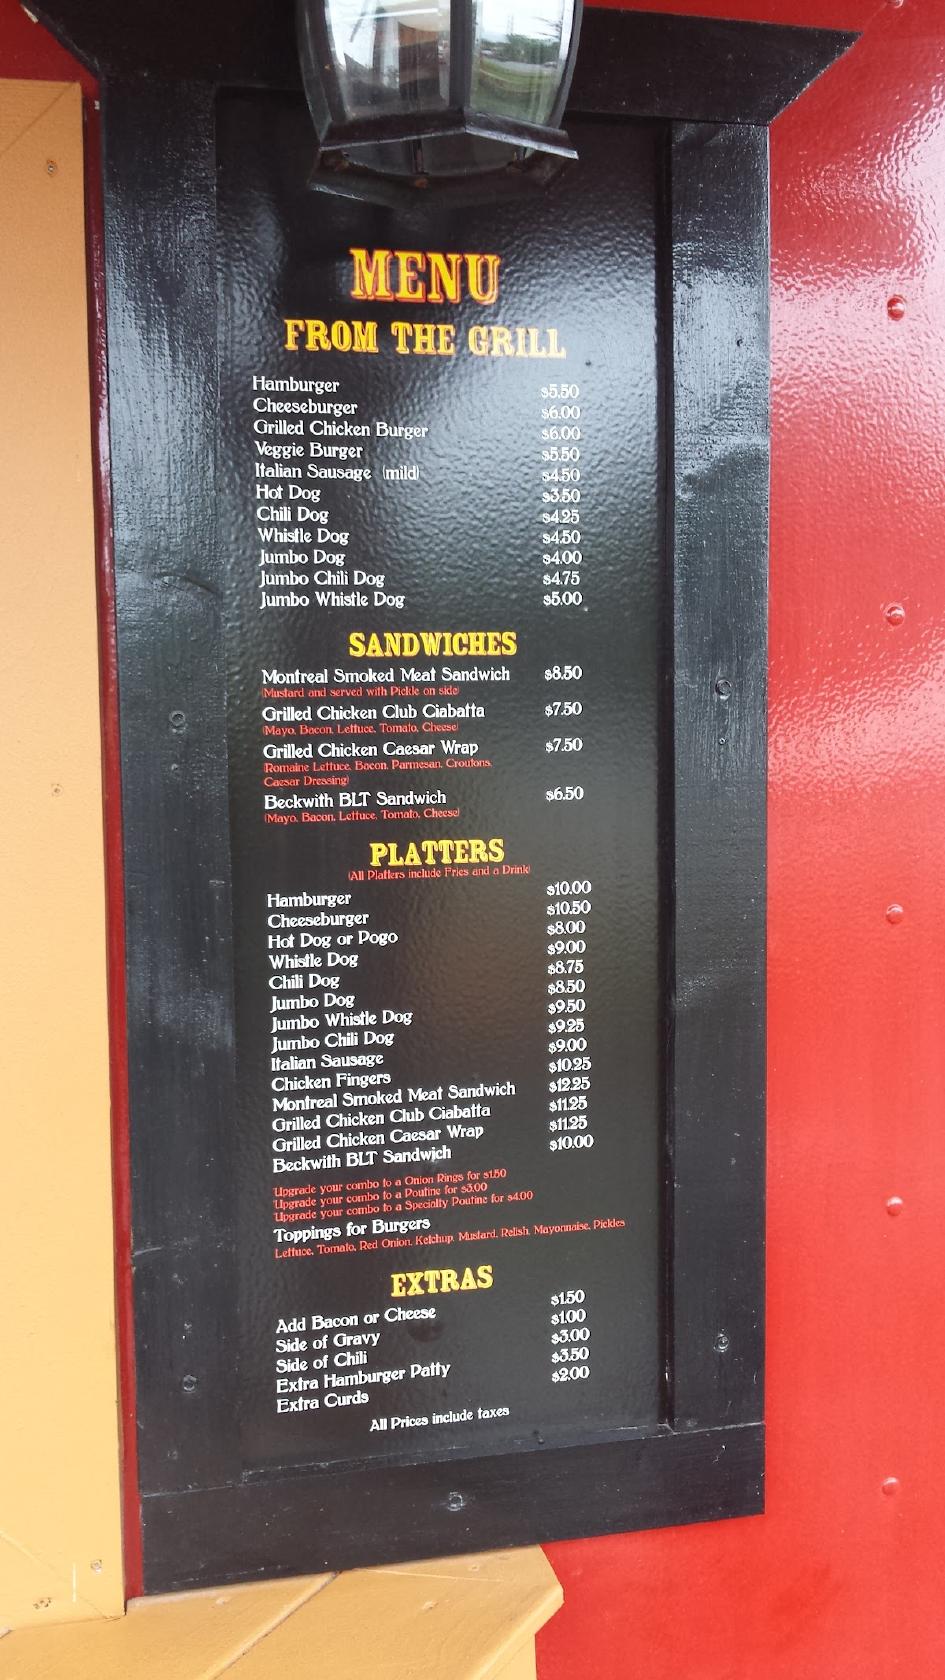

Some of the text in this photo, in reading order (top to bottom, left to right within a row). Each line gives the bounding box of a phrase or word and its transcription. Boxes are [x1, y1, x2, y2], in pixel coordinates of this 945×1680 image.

[350, 248, 500, 304] MENU
[285, 320, 566, 357] FROM THE GRILL
[253, 376, 339, 394] Hamburger
[541, 384, 579, 399] $5.50
[253, 398, 358, 417] Cheeseburger
[542, 405, 580, 420] $6.00
[254, 420, 429, 441] Grilled Chicken Burger
[542, 426, 580, 440] $6.00
[254, 441, 363, 460] Veggie Burger
[542, 446, 580, 462] $5.50
[255, 462, 420, 482] Italian Sausage (mild)
[541, 467, 580, 483] $4.50
[256, 484, 320, 502] Hot Dog
[542, 487, 580, 503] $3.50
[257, 506, 329, 524] Chili Dog
[540, 508, 579, 524] $4.25
[258, 528, 349, 546] Whistle Dog
[543, 529, 581, 544] $4.50
[258, 549, 346, 566] Jumbo Dog
[543, 550, 582, 565] $4.00
[259, 570, 385, 588] Jumbo Chili Dog
[543, 571, 580, 585] $4.75
[260, 592, 405, 609] Jumbo Whistle Dog
[543, 591, 582, 606] $5.00
[349, 632, 517, 656] SANDWICHES
[262, 666, 510, 684] Montreal Smoked Meat Sandwich
[545, 666, 582, 680] $8.50
[262, 703, 484, 721] Grilled Chicken Club Ciabatta
[545, 702, 582, 717] $7.50
[263, 740, 478, 758] Grilled Chicken Caesar Wrap
[546, 738, 582, 753] $7.50
[265, 790, 446, 809] Beckwith BLT Sandwich
[546, 786, 584, 802] $6.50
[370, 839, 504, 866] PLATTERS
[368, 870, 405, 880] Platters
[408, 869, 441, 878] include
[445, 868, 469, 877] Fries
[472, 867, 490, 876] and
[493, 868, 499, 876] a
[547, 881, 591, 896] $10.00
[267, 892, 351, 907] Hamburger
[547, 900, 591, 916] $10.50
[268, 912, 369, 928] Cheeseburger
[547, 920, 586, 936] $8.00
[268, 930, 398, 948] Hot Dog or Pogo
[548, 940, 586, 955] $9.00
[269, 952, 358, 969] Whistle Dog
[548, 960, 584, 975] $8.75
[548, 979, 585, 995] $8.50
[270, 993, 355, 1013] Jumbo Dog
[548, 999, 585, 1015] $9.50
[548, 1018, 584, 1034] $9.25
[548, 1038, 587, 1054] $9.00
[272, 1054, 383, 1071] Italian Sausage
[549, 1057, 591, 1073] $10.25
[272, 1073, 391, 1091] Chicken Fingers
[272, 1082, 515, 1111] Montreal Smoked Meat Sandwich
[550, 1134, 594, 1152] $10.00
[273, 1145, 451, 1173] Beckwith BLT Sandwich
[273, 1210, 316, 1222] Upgrade
[320, 1208, 343, 1218] your
[347, 1205, 379, 1216] combo
[383, 1203, 392, 1212] to
[395, 1203, 402, 1212] a
[405, 1197, 449, 1211] Specialty
[451, 1196, 488, 1206] Poutine
[492, 1193, 504, 1203] for
[273, 1219, 430, 1243] Toppings for Burgers
[360, 1241, 377, 1250] Red
[593, 1219, 625, 1228] Pickles
[391, 1265, 493, 1297] EXTRAS
[276, 1307, 436, 1333] Add Bacon or Cheese
[276, 1333, 380, 1352] Side of Gravy
[552, 1328, 590, 1344] $3.00
[276, 1351, 367, 1373] Side of Chili
[552, 1347, 589, 1364] $3.50
[277, 1362, 450, 1393] Extra Hamburger Patty
[552, 1366, 590, 1383] $2.00
[277, 1390, 369, 1413] Extra Curds
[370, 1407, 509, 1432] All Prices include taxes
